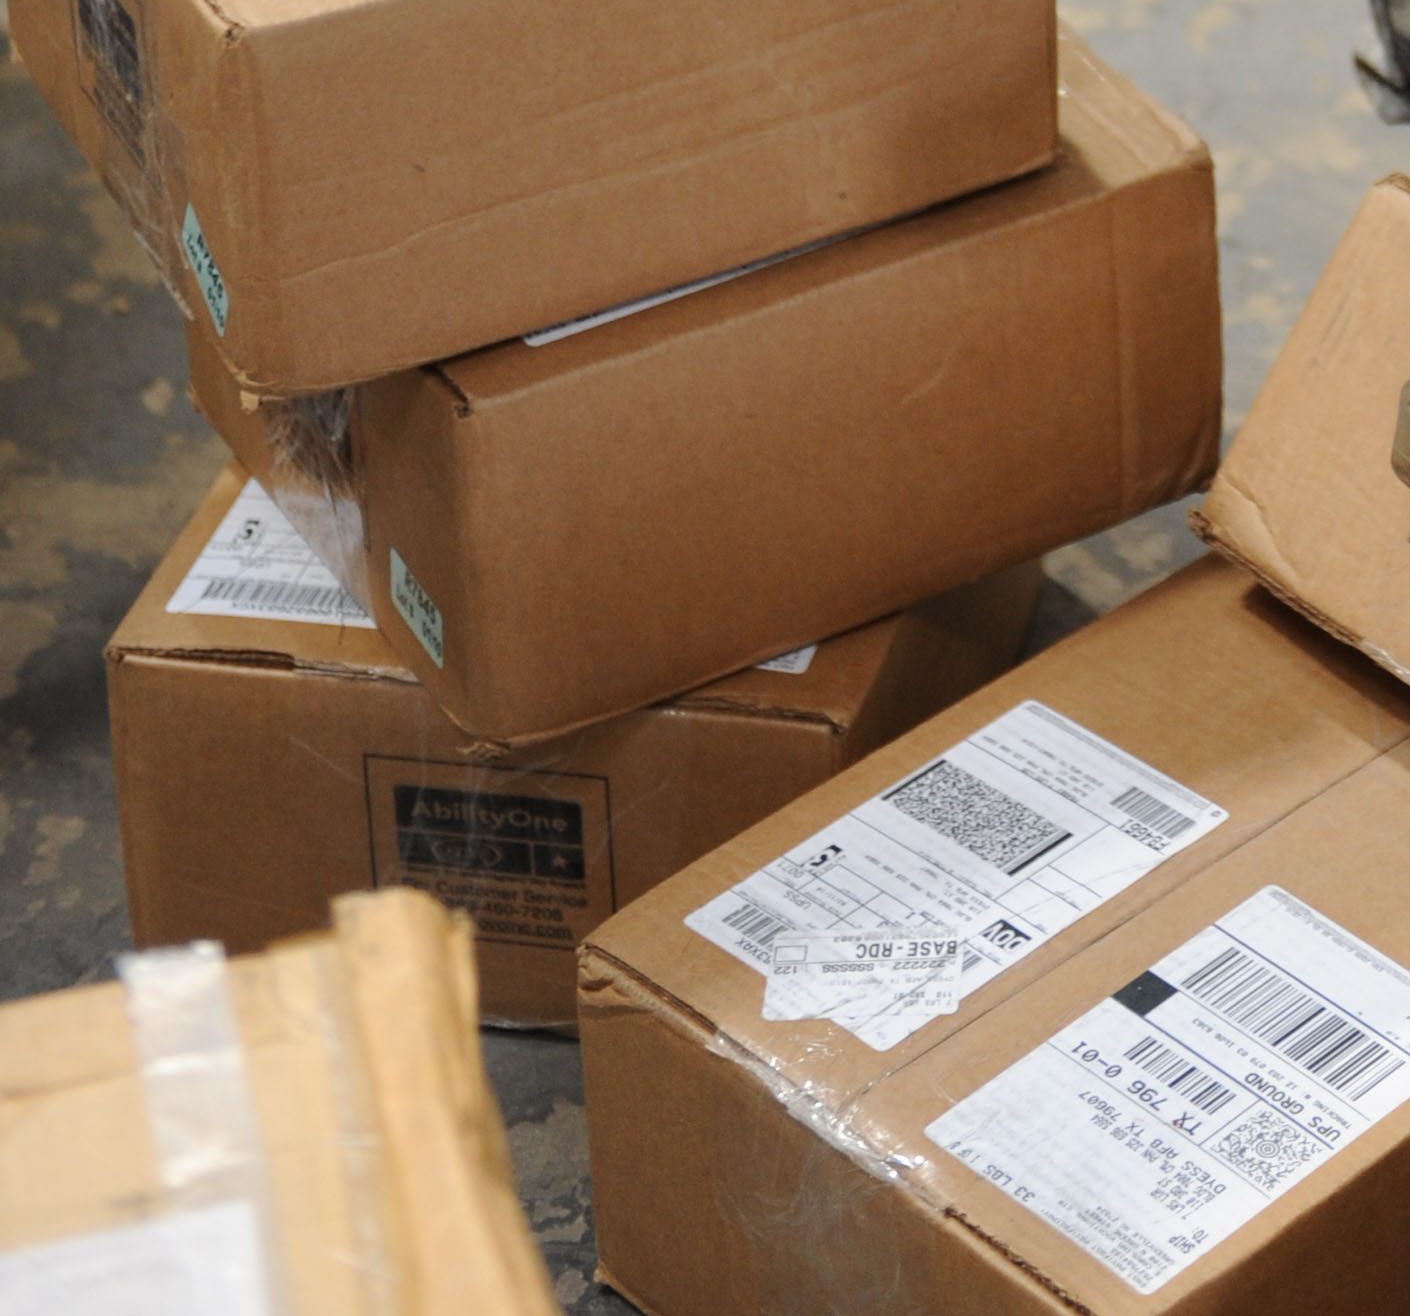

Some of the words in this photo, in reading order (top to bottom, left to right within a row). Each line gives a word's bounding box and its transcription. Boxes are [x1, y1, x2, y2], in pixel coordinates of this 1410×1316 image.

[411, 798, 569, 833] AbilityOne
[1115, 817, 1172, 852] FB4661
[977, 918, 1033, 954] DOV
[772, 965, 798, 975] 122
[820, 962, 874, 973] SSSSSS
[1067, 1039, 1125, 1080] 0-01
[1076, 1086, 1125, 1122] 79607
[1123, 1077, 1171, 1112] 796
[1240, 1069, 1307, 1117] GROUND
[1169, 1109, 1207, 1137] TX
[1309, 1098, 1354, 1130] TRACKING
[1122, 1119, 1148, 1138] TX
[1304, 1113, 1344, 1143] UPS
[1146, 1136, 1180, 1161] AFB
[980, 1161, 1014, 1186] LBS
[1155, 1175, 1173, 1188] ST
[1177, 1158, 1228, 1195] DYESS
[1011, 1184, 1037, 1203] 33
[1147, 1185, 1171, 1203] LGR
[1167, 1183, 1190, 1200] 3RD
[1183, 1195, 1206, 1211] 110
[1190, 1184, 1216, 1203] BLDG
[1163, 1197, 1186, 1214] LRS
[1165, 1231, 1198, 1255] SHIP
